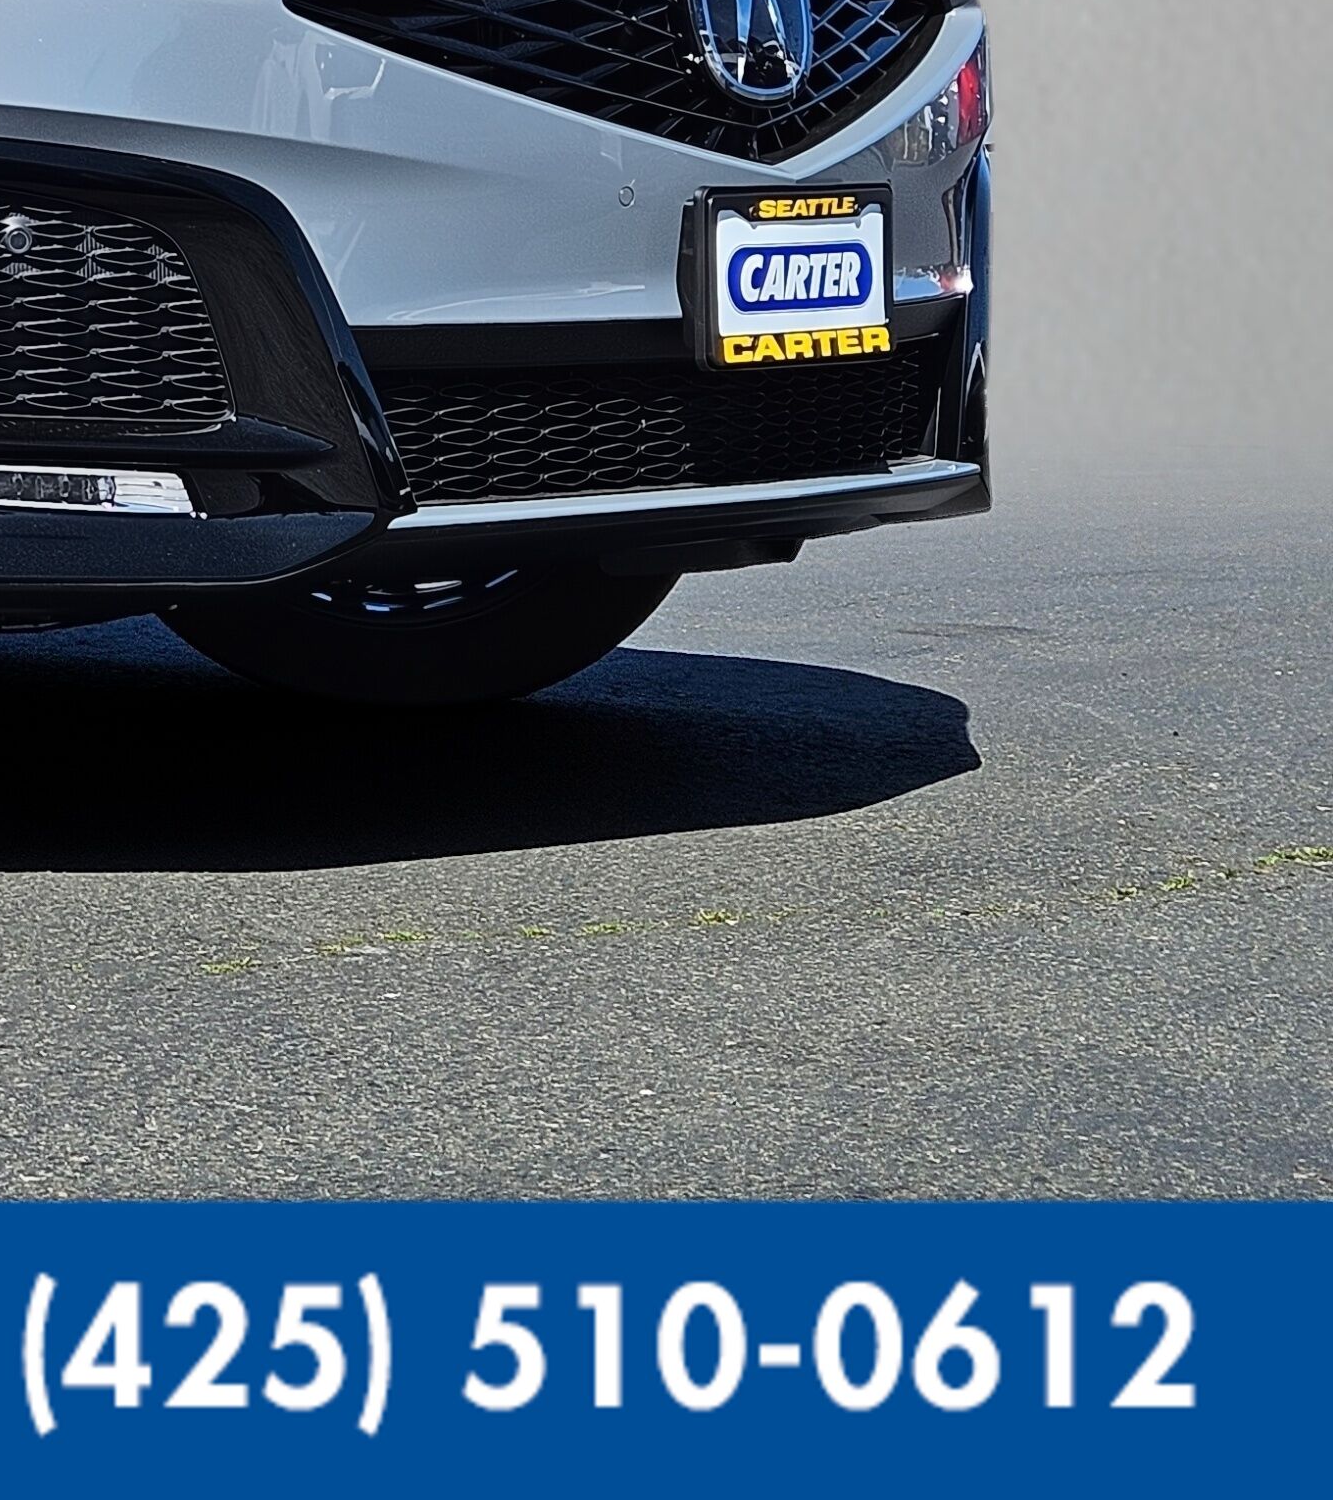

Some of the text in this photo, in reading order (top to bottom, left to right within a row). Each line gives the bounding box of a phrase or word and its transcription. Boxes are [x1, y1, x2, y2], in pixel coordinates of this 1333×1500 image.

[758, 197, 856, 218] SEATTLE
[740, 251, 861, 303] CARTER
[722, 326, 891, 364] CARTER
